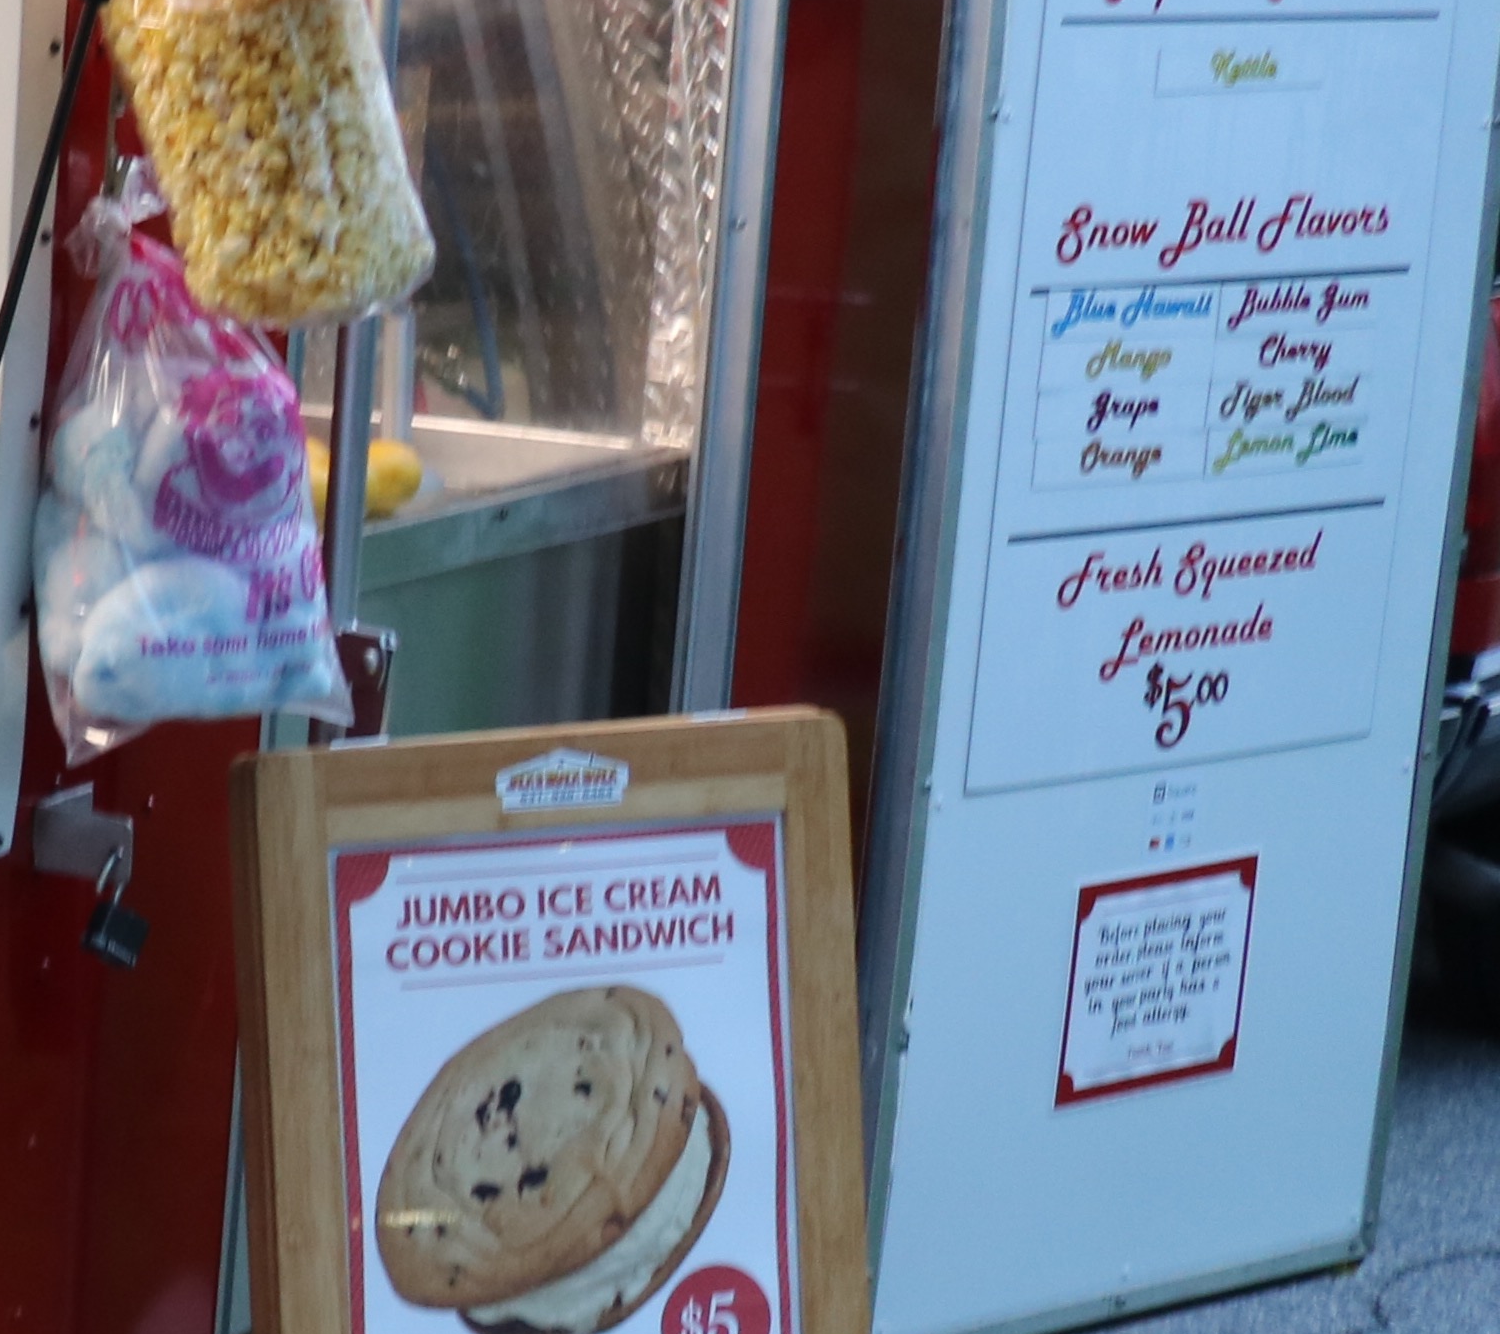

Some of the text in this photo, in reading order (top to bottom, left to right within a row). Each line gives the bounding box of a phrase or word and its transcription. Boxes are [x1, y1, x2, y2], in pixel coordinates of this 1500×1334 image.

[1210, 46, 1278, 86] Kettle
[1056, 195, 1390, 269] Snow Ball Flavors
[1052, 285, 1213, 338] Blue Hawaii
[1227, 280, 1370, 331] Bubble Gum
[1086, 339, 1172, 380] Mango
[1259, 333, 1332, 373] Cherry
[1087, 390, 1159, 432] Grape
[1220, 373, 1360, 422] Tiger Blood
[1080, 438, 1162, 479] Orange
[1213, 421, 1358, 474] Lemon Lime
[1057, 531, 1323, 609] Fresh Squeezed
[1100, 603, 1273, 681] Lemonade
[396, 873, 722, 930] JUMBO ICE CREAM
[385, 911, 735, 973] COOKIE SANDWICH
